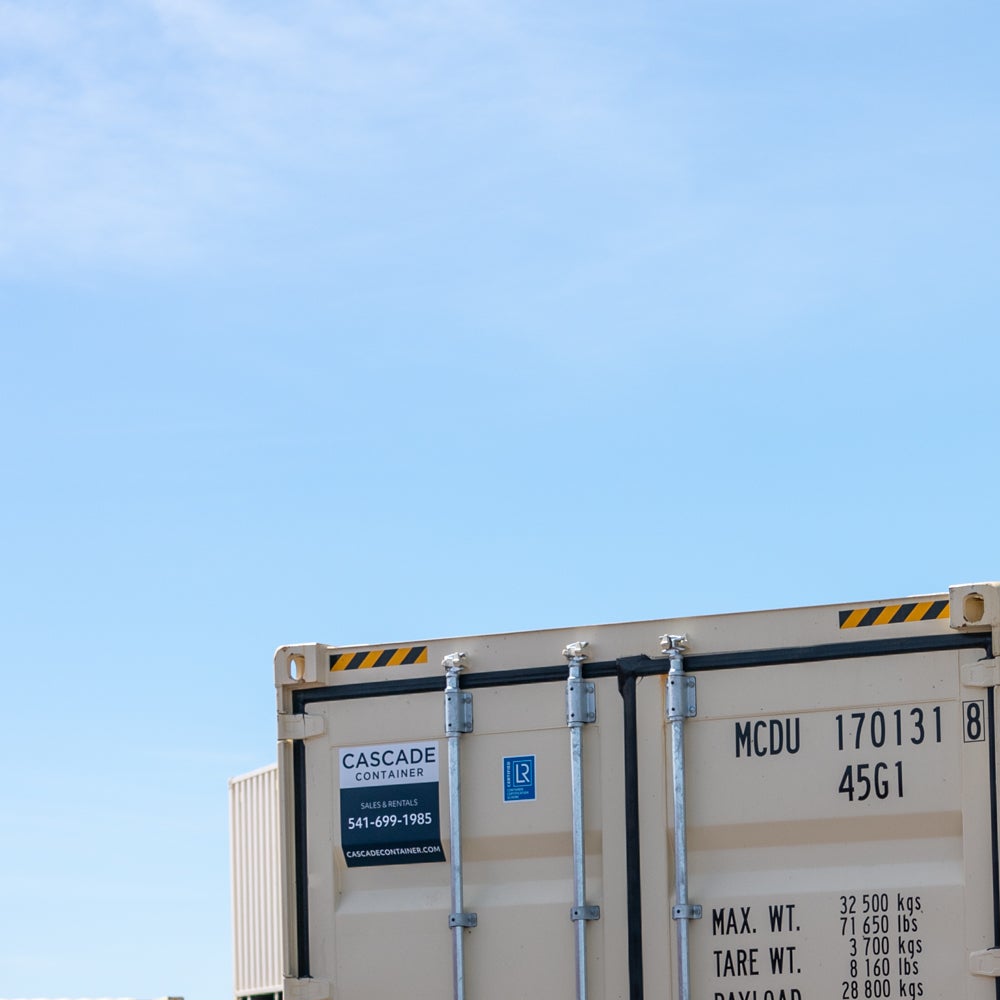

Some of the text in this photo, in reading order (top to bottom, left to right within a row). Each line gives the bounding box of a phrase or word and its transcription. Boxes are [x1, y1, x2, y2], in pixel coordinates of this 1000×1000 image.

[736, 703, 981, 757] MCDU 170131 8
[342, 747, 436, 769] CASCADE
[355, 768, 424, 782] CONTAINER
[838, 761, 904, 801] 45G1
[360, 799, 418, 809] SALES & RENTALS
[348, 812, 432, 830] 541-699-1985
[346, 846, 441, 858] CASCADECONTAINER.COM
[840, 893, 921, 917] 32 500 kgs
[712, 904, 801, 935] MAX. WT.
[840, 914, 918, 935] 71 650 lbs
[849, 937, 923, 958] 3 700 kgs
[714, 946, 801, 977] TARE WT.
[850, 957, 919, 978] 8 160 lbs
[842, 981, 859, 999] 28
[864, 980, 891, 998] 800
